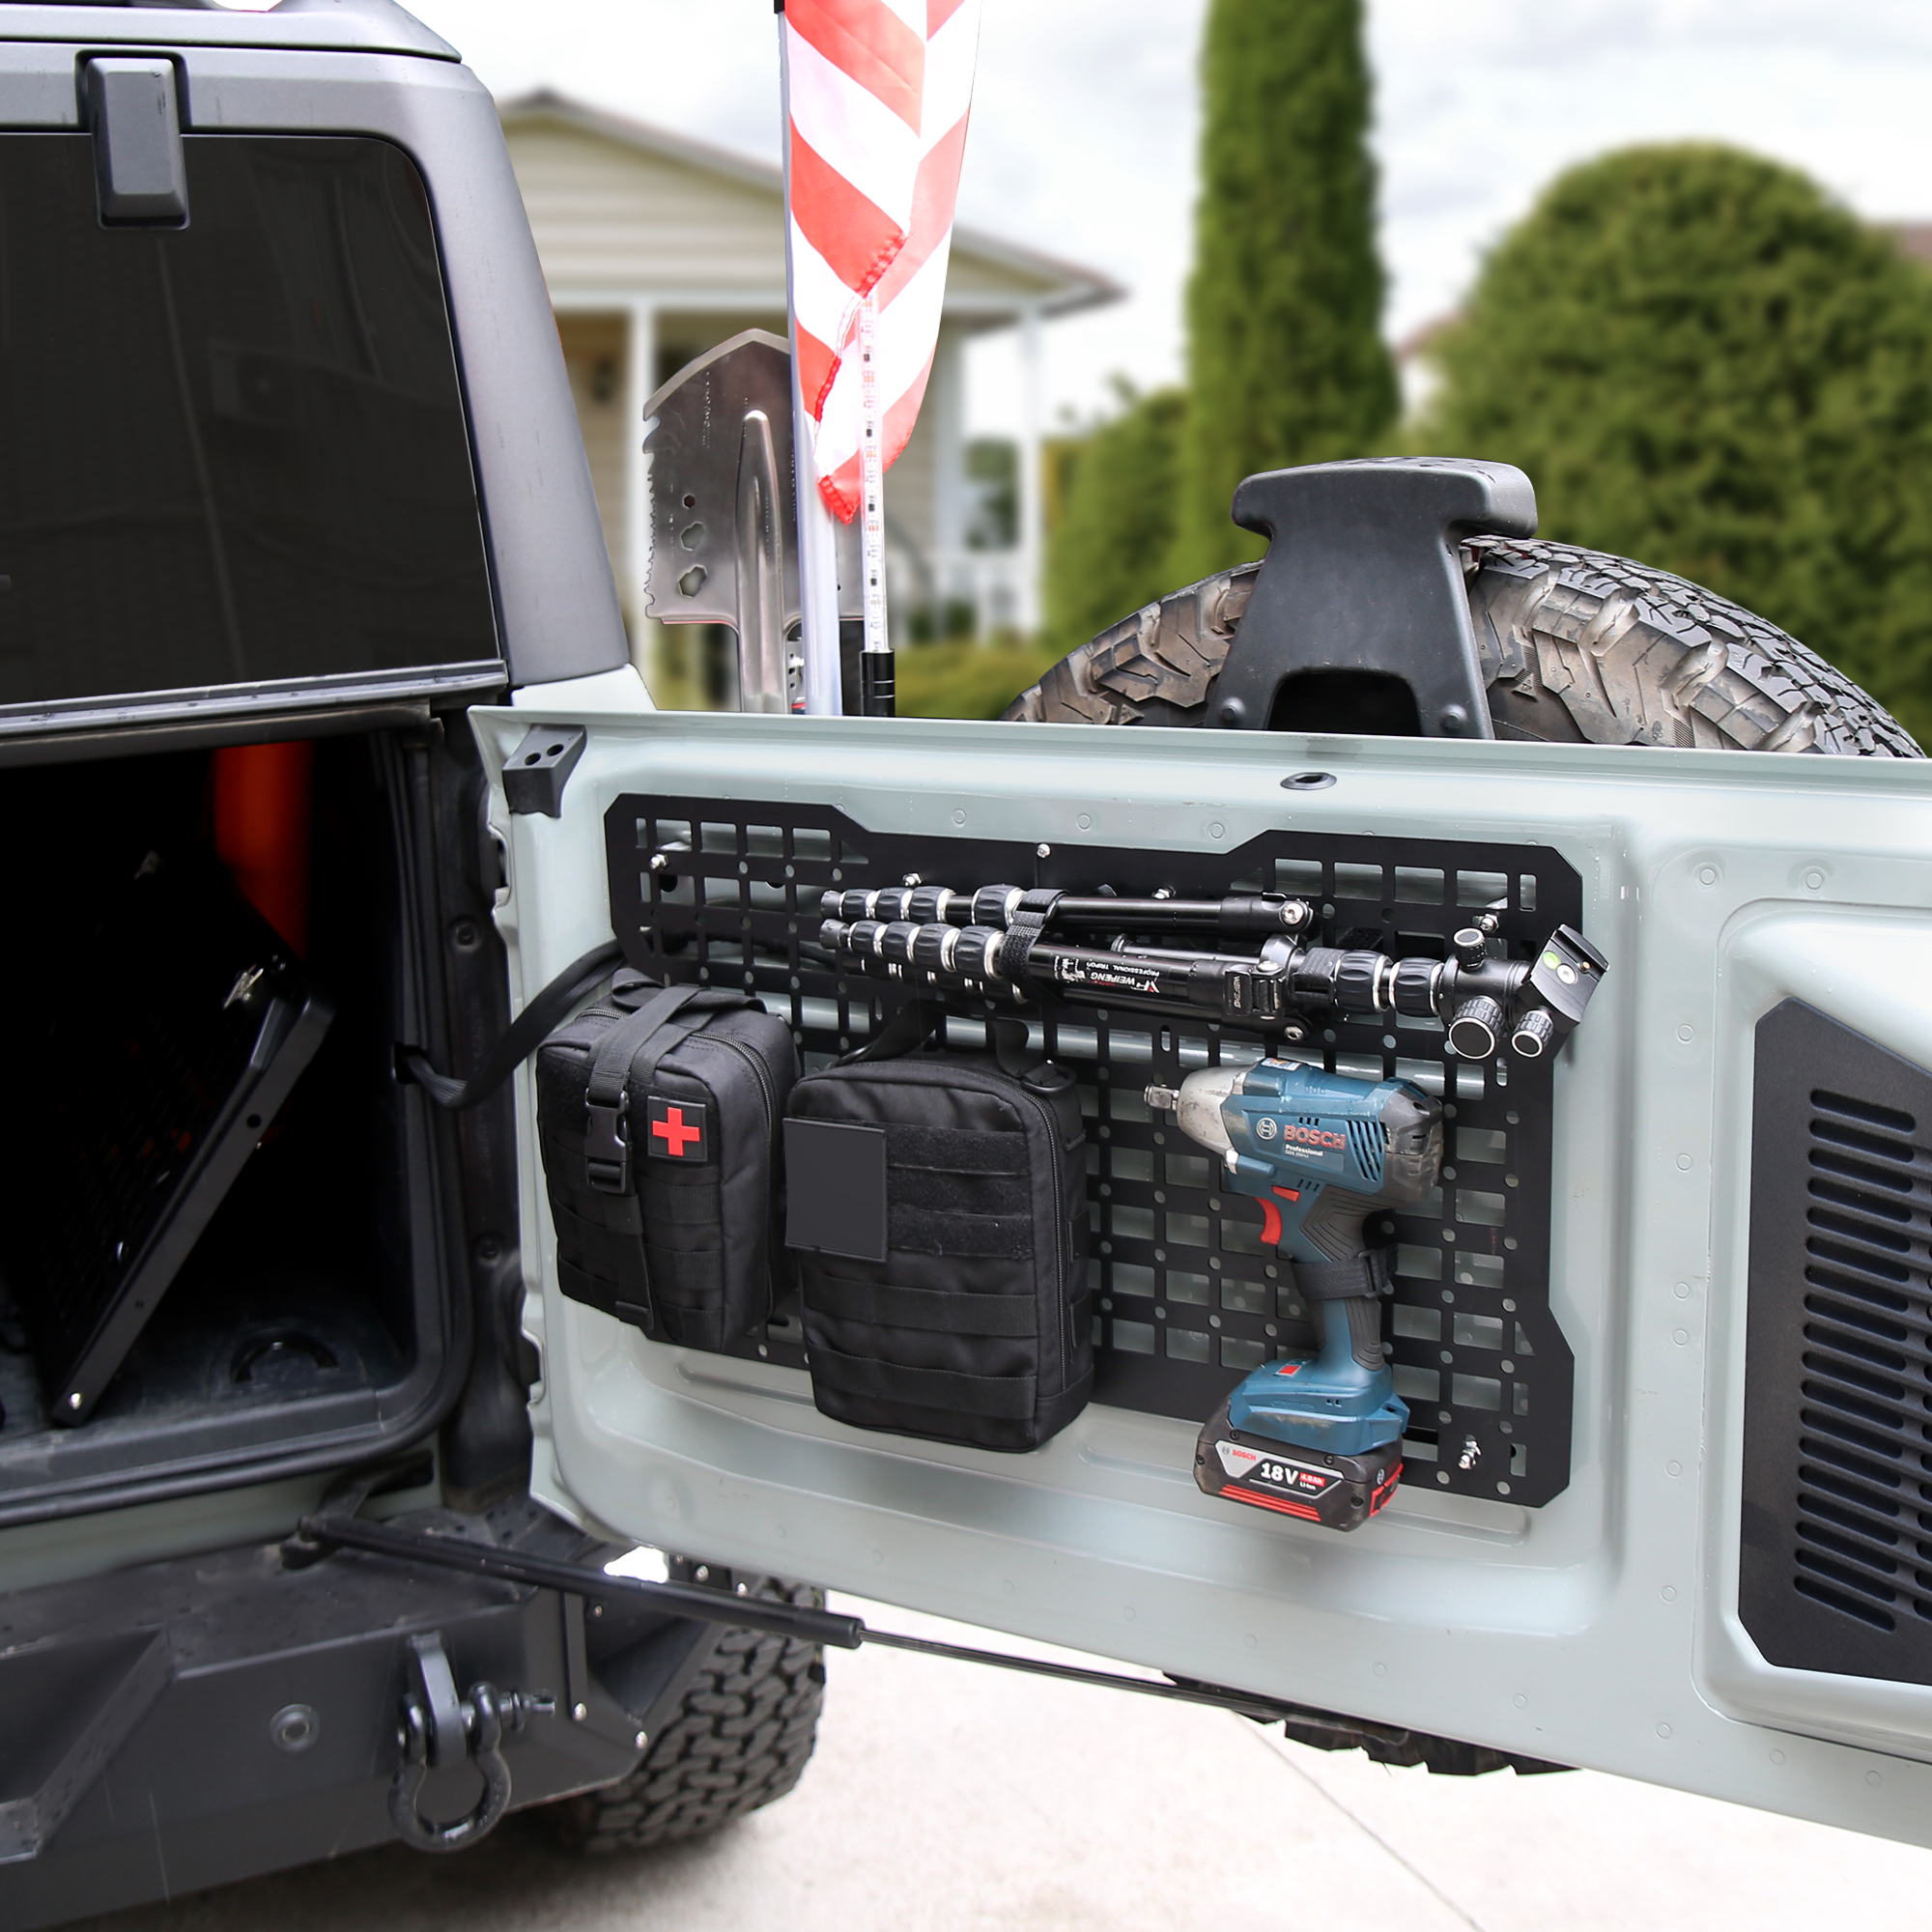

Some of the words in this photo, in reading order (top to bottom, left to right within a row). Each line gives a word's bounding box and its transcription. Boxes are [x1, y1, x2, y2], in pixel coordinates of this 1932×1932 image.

[1113, 964, 1160, 977] PROFESSIONAL
[1284, 1124, 1347, 1151] BOSCH
[1285, 1144, 1323, 1156] Professional
[1232, 1449, 1258, 1462] BOSCH
[1261, 1462, 1299, 1485] 18V
[1300, 1473, 1323, 1485] 4.0Ah
